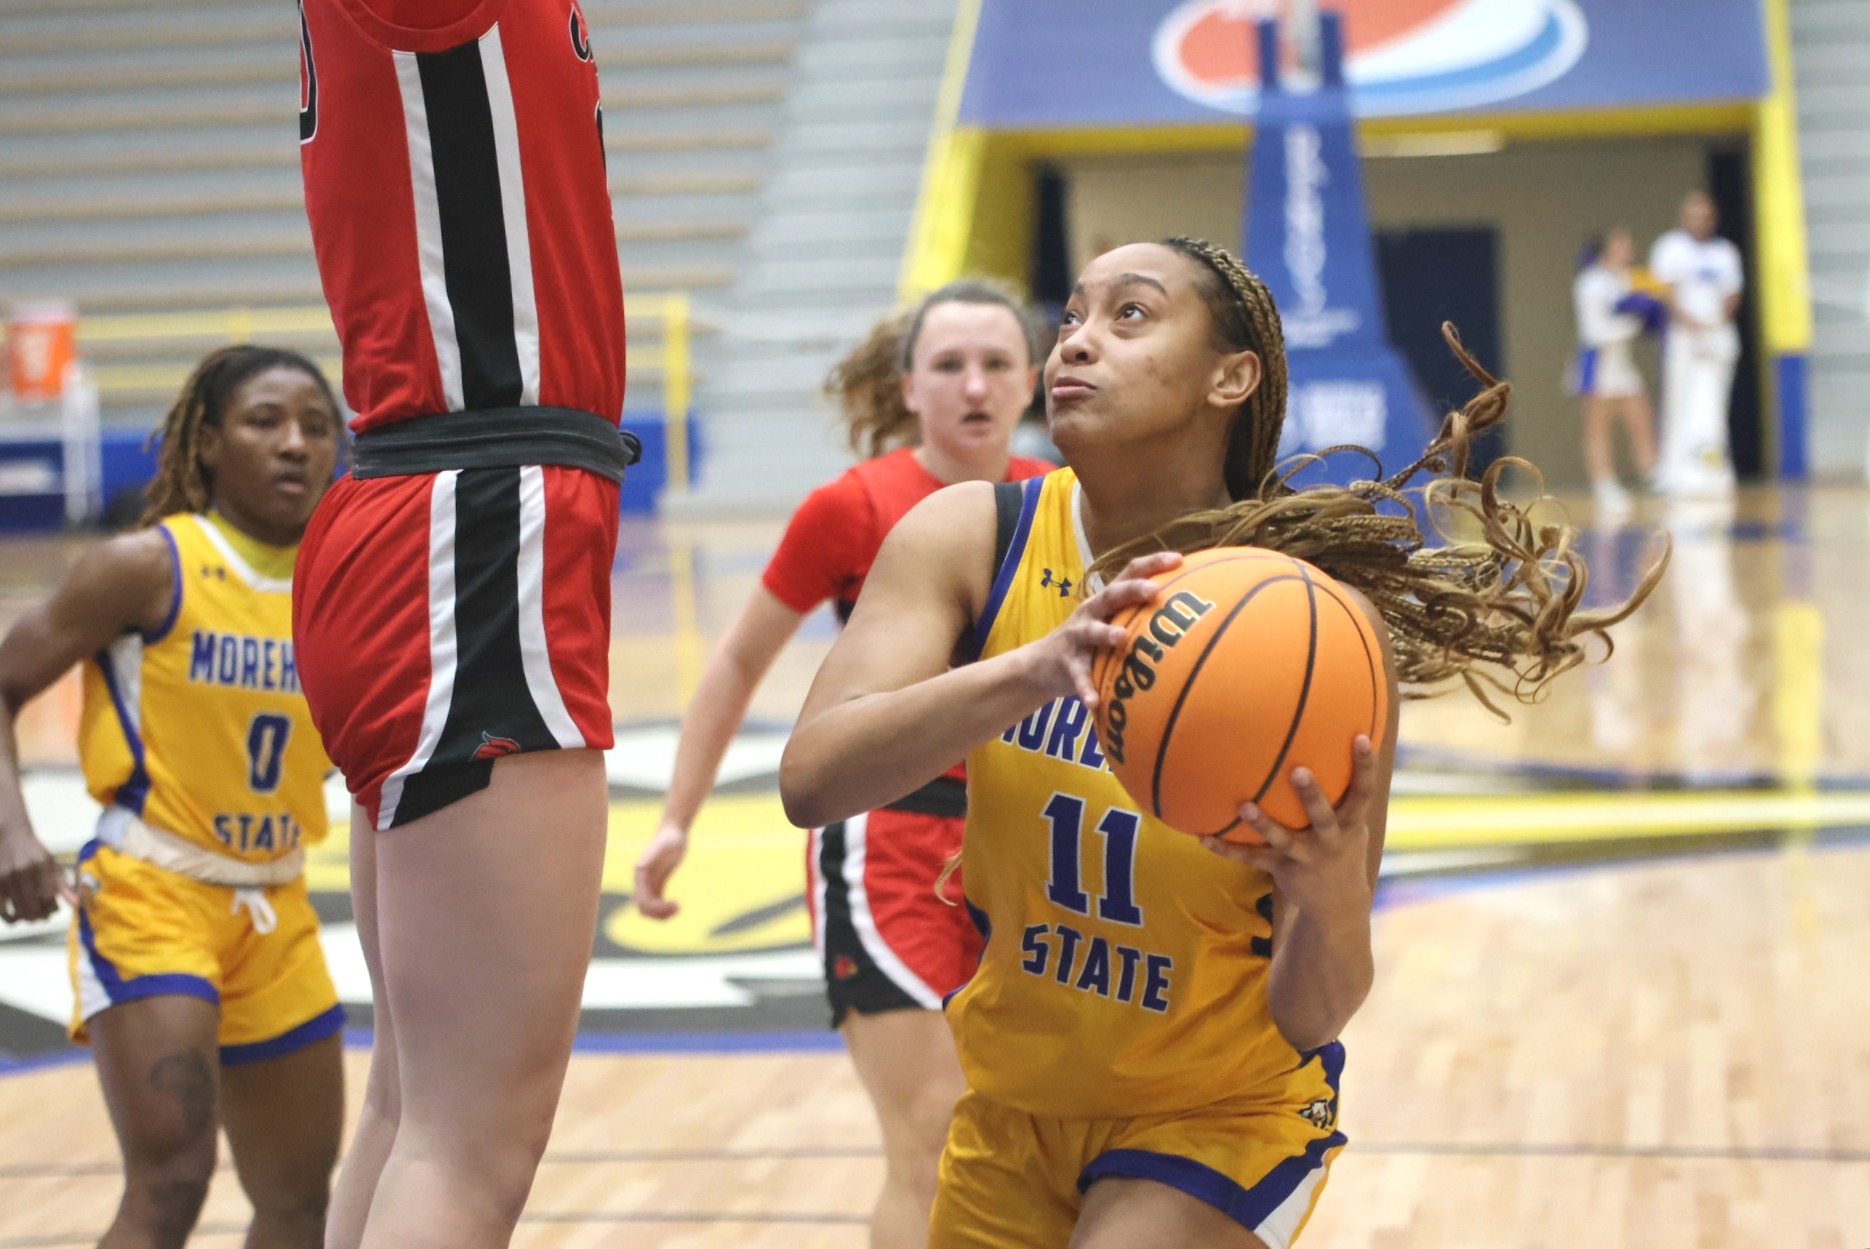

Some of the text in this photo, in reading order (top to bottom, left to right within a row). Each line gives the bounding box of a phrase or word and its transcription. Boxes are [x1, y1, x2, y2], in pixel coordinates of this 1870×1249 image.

[1113, 591, 1216, 764] Wilson
[247, 712, 292, 794] 0
[1039, 790, 1145, 928] 11
[1020, 922, 1174, 1015] STATE
